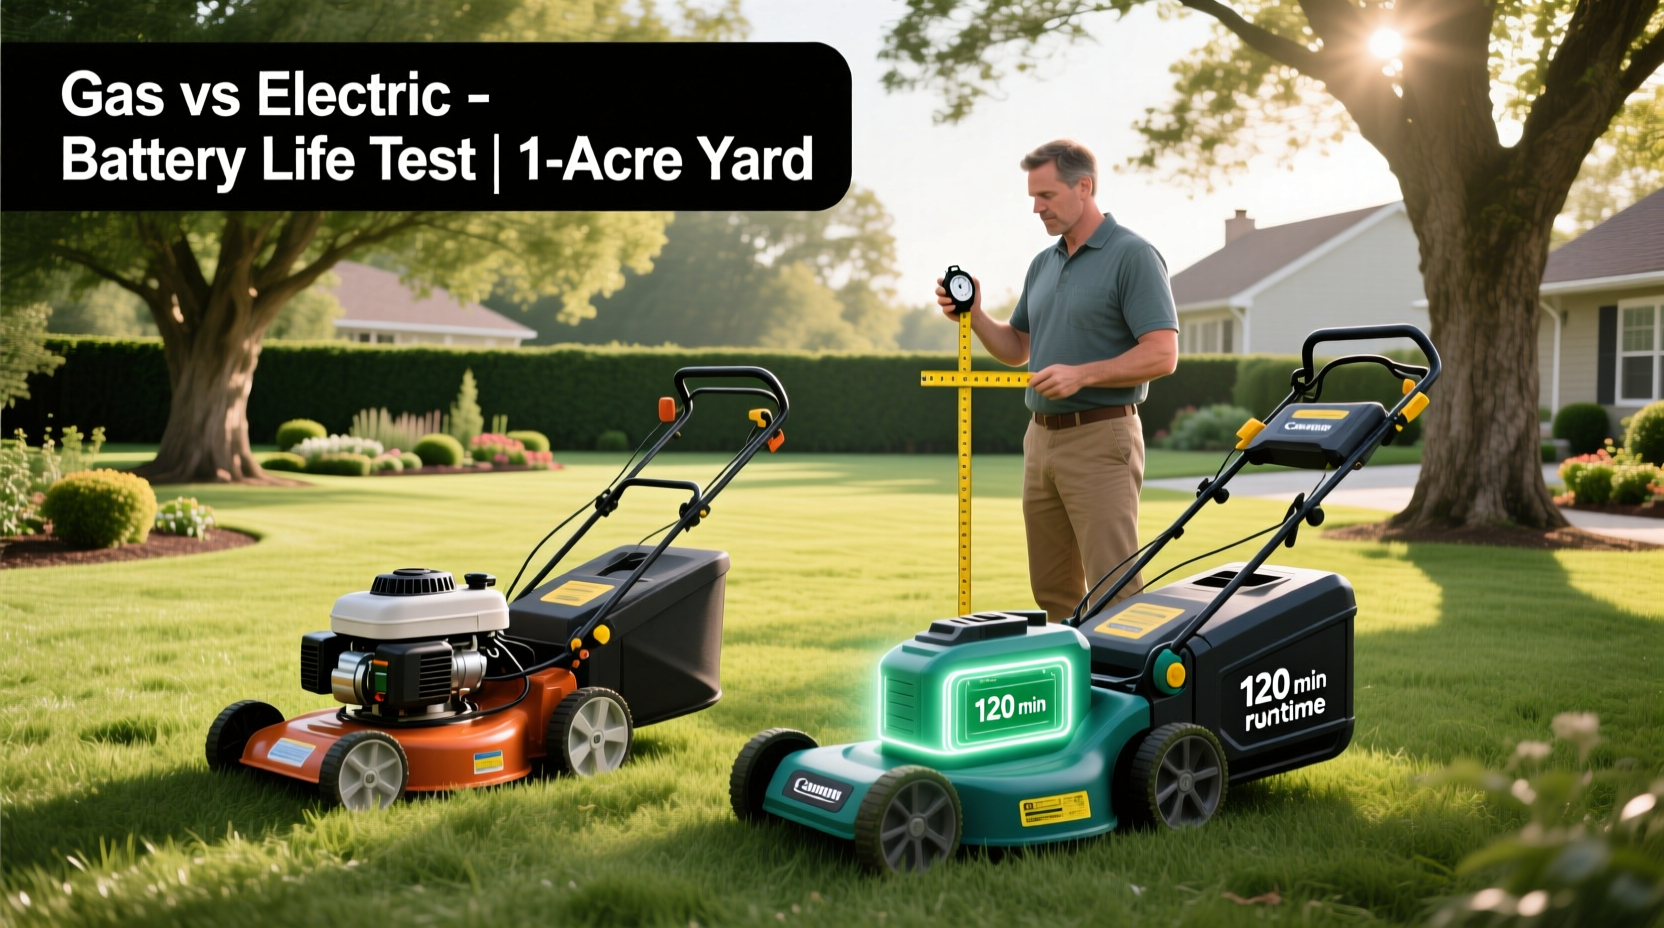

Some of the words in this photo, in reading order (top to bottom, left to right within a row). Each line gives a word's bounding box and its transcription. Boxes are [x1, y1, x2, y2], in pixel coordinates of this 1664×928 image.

[1240, 667, 1291, 707] 120
[1293, 669, 1327, 695] min
[975, 693, 1015, 723] 120
[1018, 696, 1047, 715] min
[1245, 697, 1326, 732] runtime
